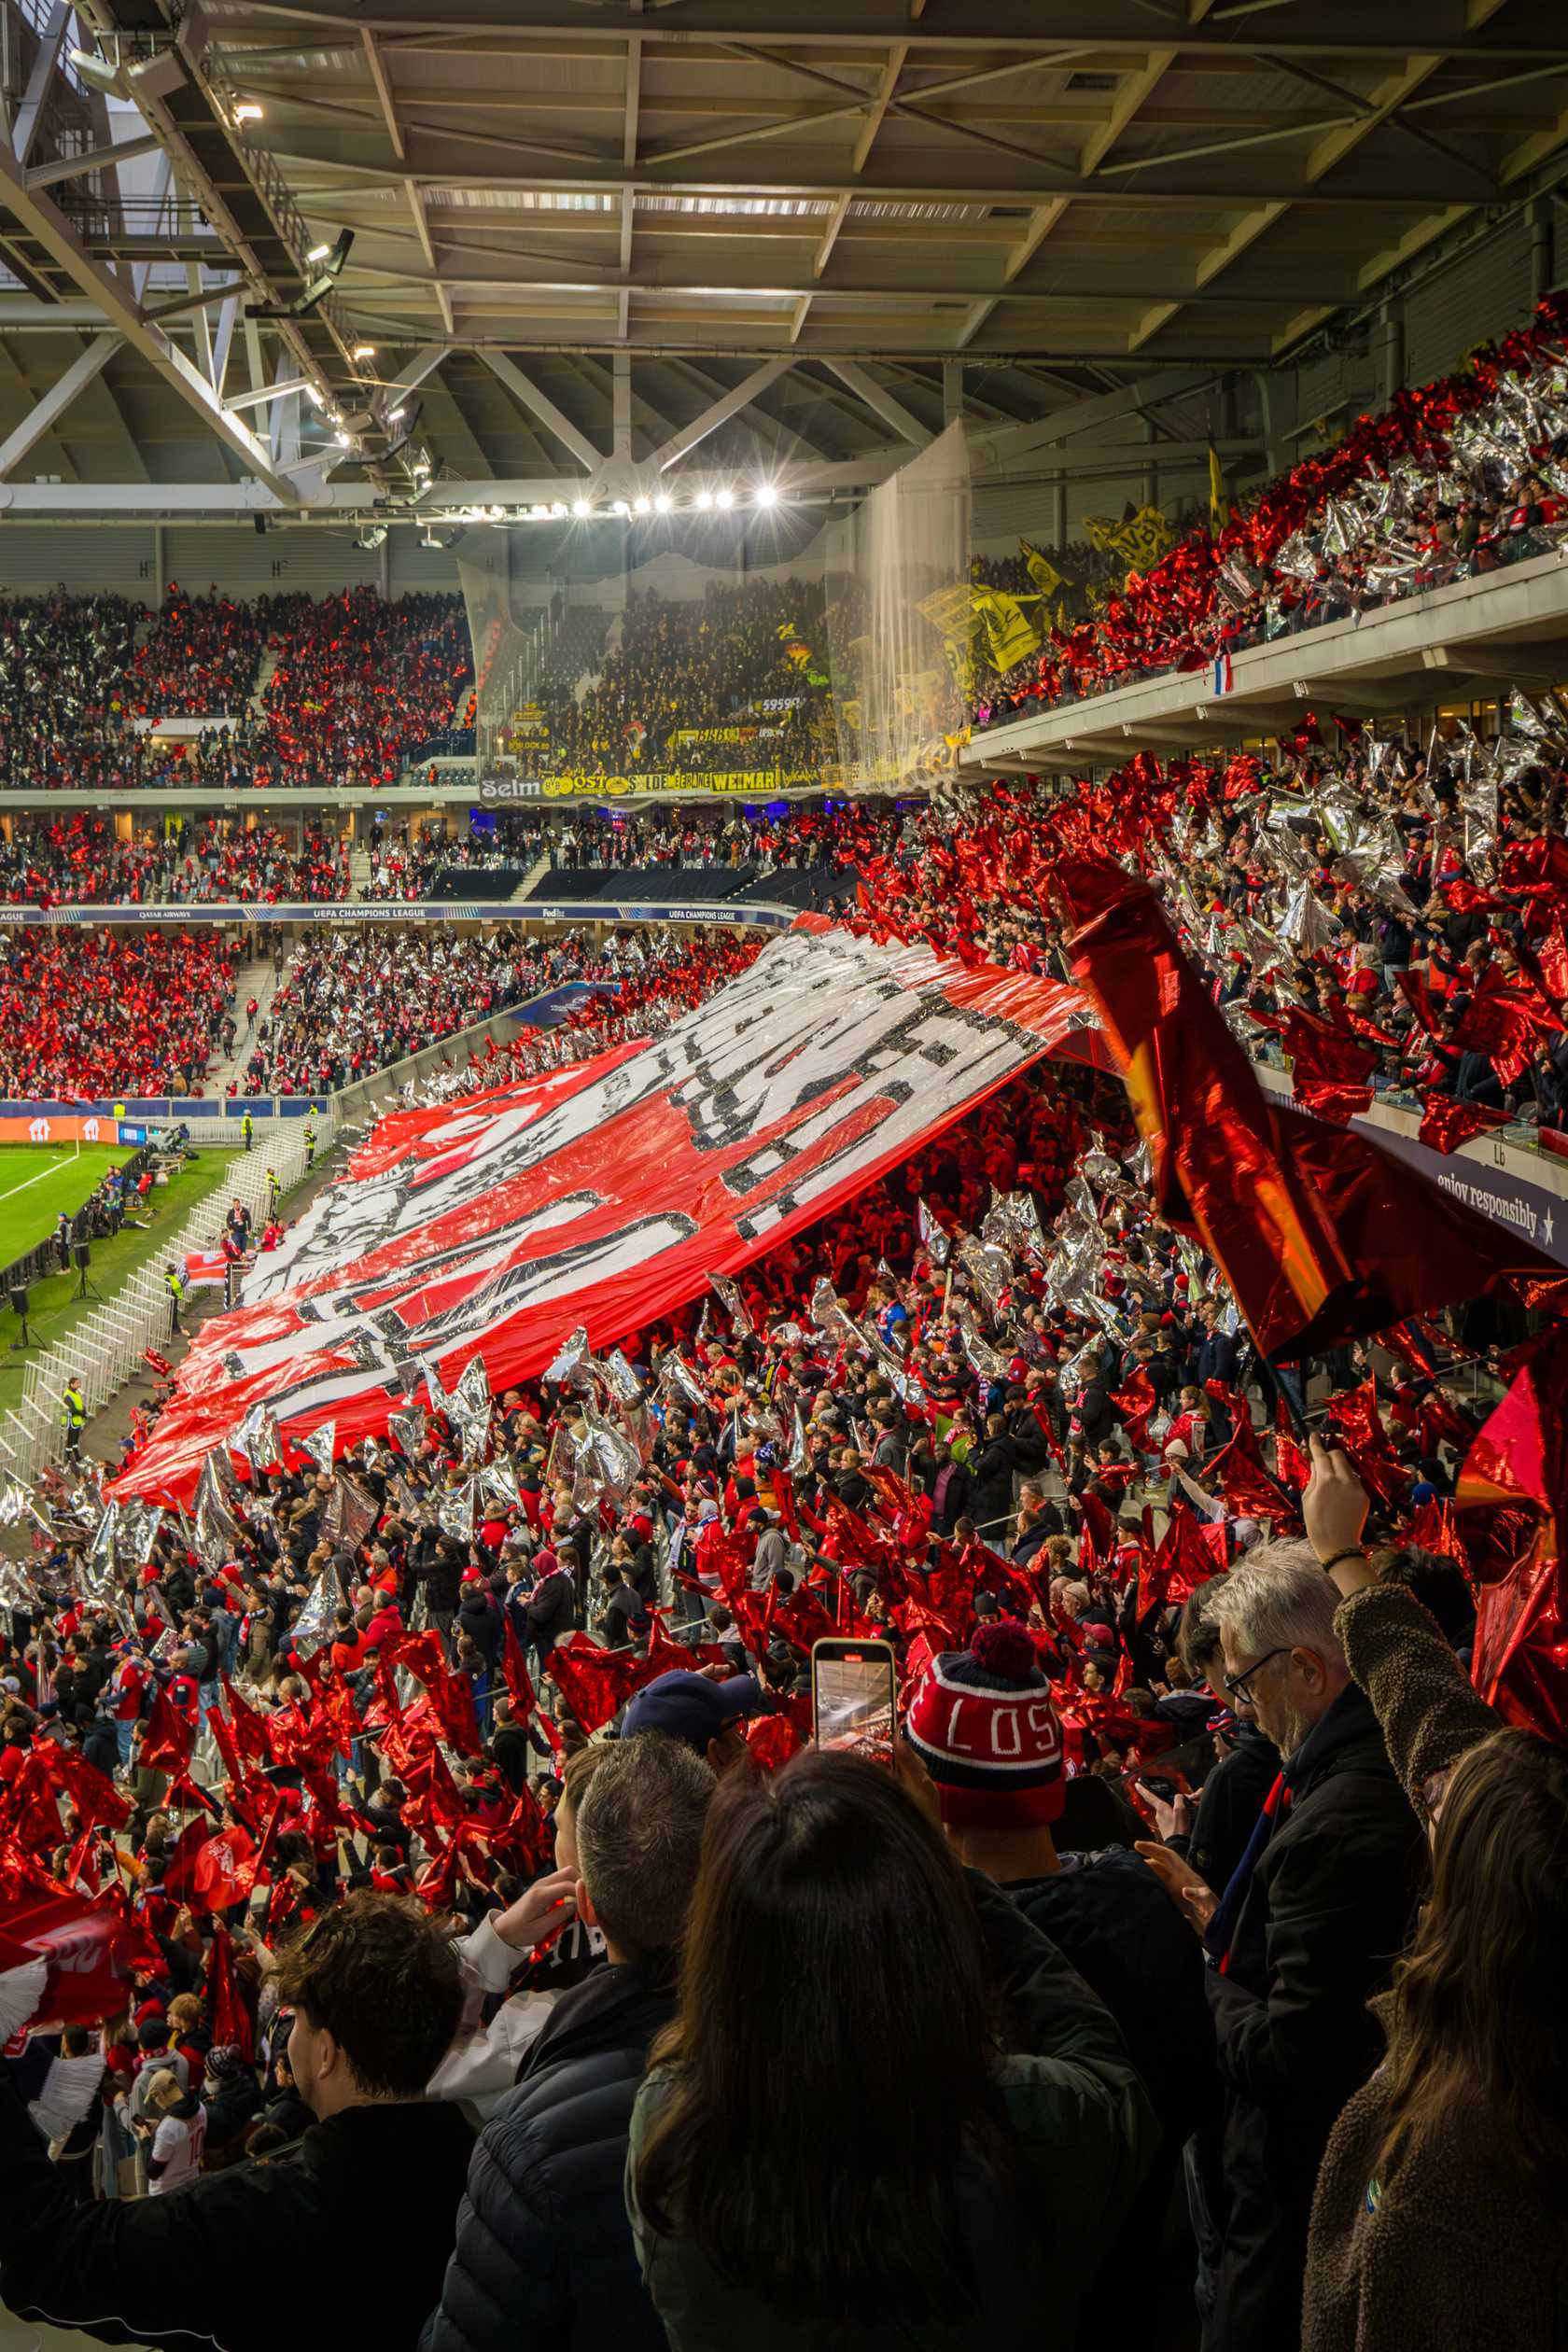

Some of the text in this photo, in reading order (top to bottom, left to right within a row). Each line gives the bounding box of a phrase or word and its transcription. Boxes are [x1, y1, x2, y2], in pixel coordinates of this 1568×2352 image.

[482, 778, 540, 798] Selm
[574, 776, 607, 789] OST
[713, 771, 776, 791] WEIMAR
[339, 909, 390, 917] CHAMPIONS
[669, 910, 735, 920] UEFA CHAMPIONS LEAGUE
[1493, 1143, 1505, 1166] Lb
[1470, 1186, 1537, 1239] responsibly
[947, 1698, 1058, 1756] LOS
